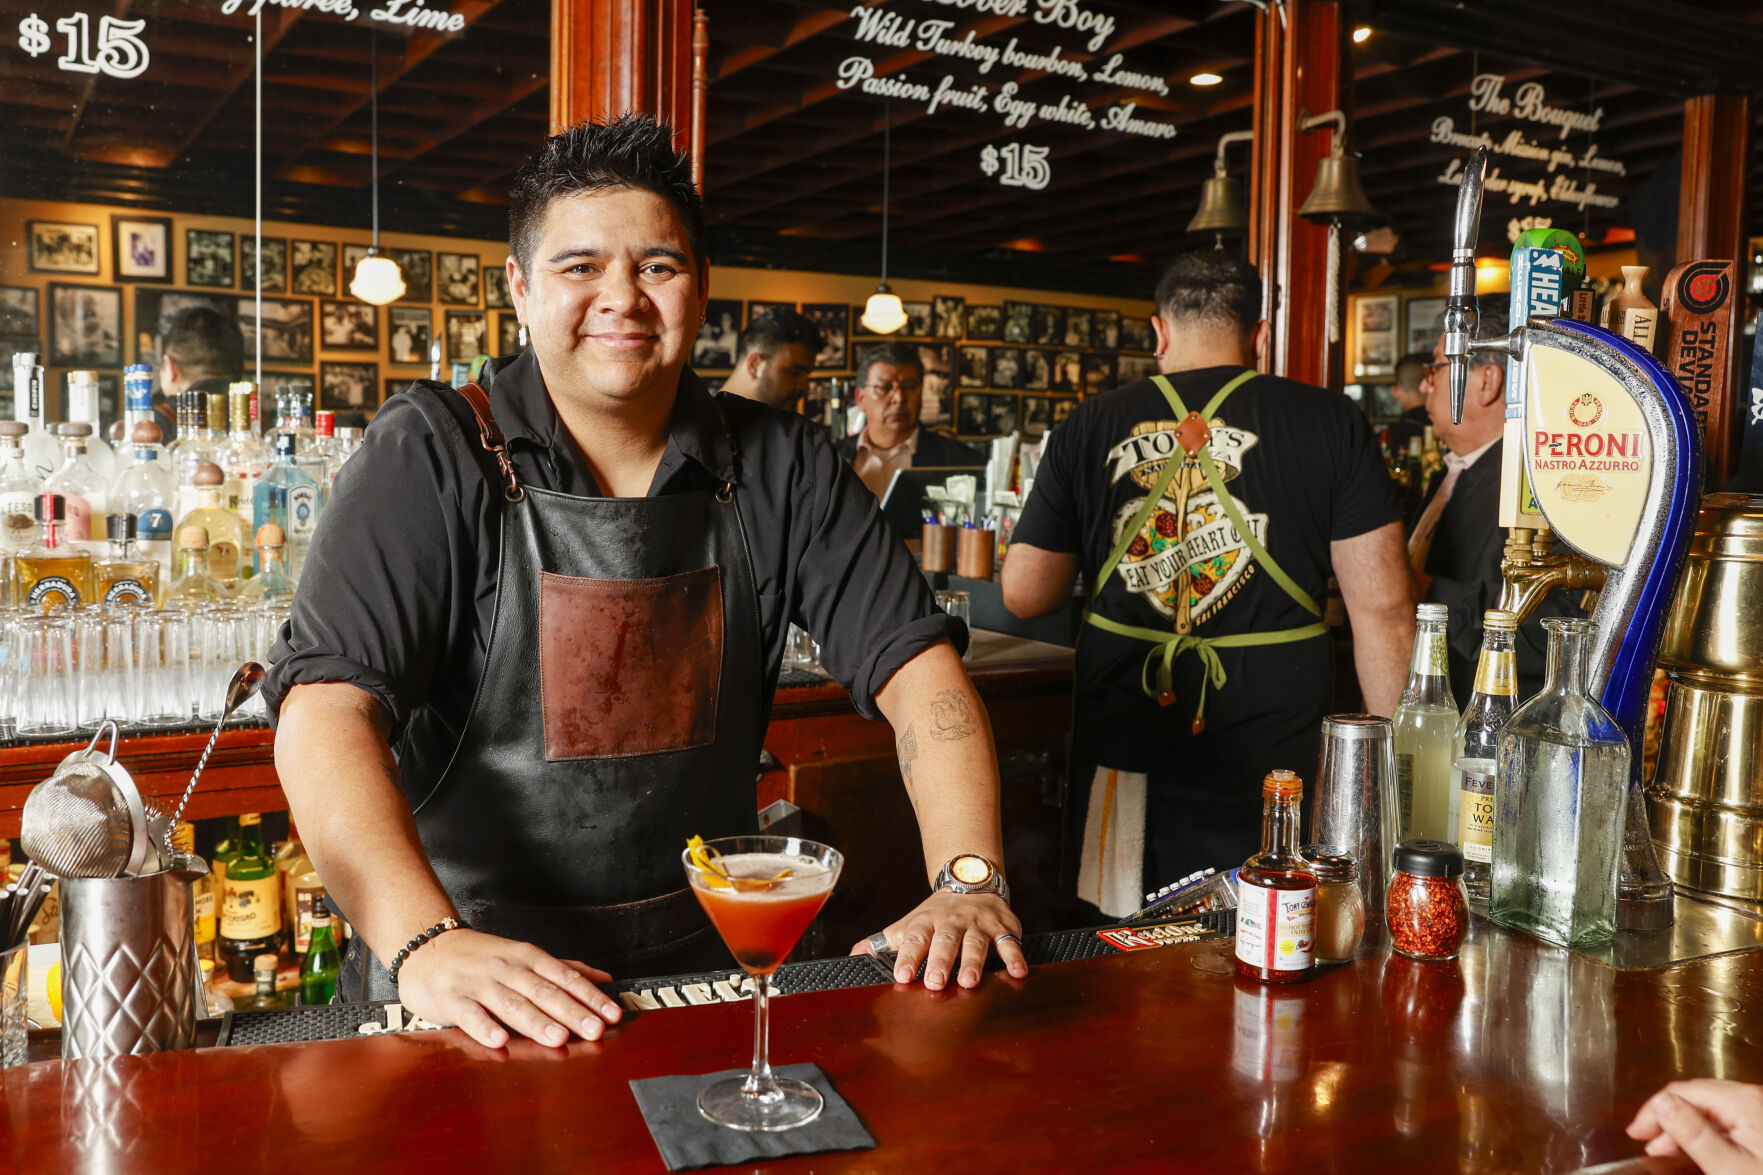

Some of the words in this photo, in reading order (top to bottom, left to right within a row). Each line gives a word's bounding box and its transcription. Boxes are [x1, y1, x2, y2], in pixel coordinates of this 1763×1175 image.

[370, 0, 465, 31] Lime
[1034, 0, 1116, 52] Boy
[18, 12, 150, 79] $15
[850, 6, 912, 49] Wild
[916, 19, 1000, 75] Turkey
[1001, 38, 1088, 82] bourbon,
[1092, 53, 1170, 96] Lemon,
[836, 56, 931, 102] Passion
[927, 75, 989, 115] fruit,
[993, 81, 1036, 129] Egg
[1039, 95, 1096, 131] white,
[1100, 102, 1178, 139] Amaro
[1469, 73, 1511, 115] The
[1513, 82, 1604, 140] Bouquet
[979, 142, 1051, 190] $15
[1534, 431, 1641, 458] PERONI
[1535, 460, 1576, 471] NASTRO
[1578, 459, 1640, 472] AZZURRO
[151, 513, 162, 528] 7
[1126, 565, 1151, 589] EAT
[1149, 549, 1188, 583] YOUR
[1186, 527, 1228, 560] HEART
[1212, 564, 1254, 614] FRANCISCO
[1465, 776, 1495, 790] FEVE
